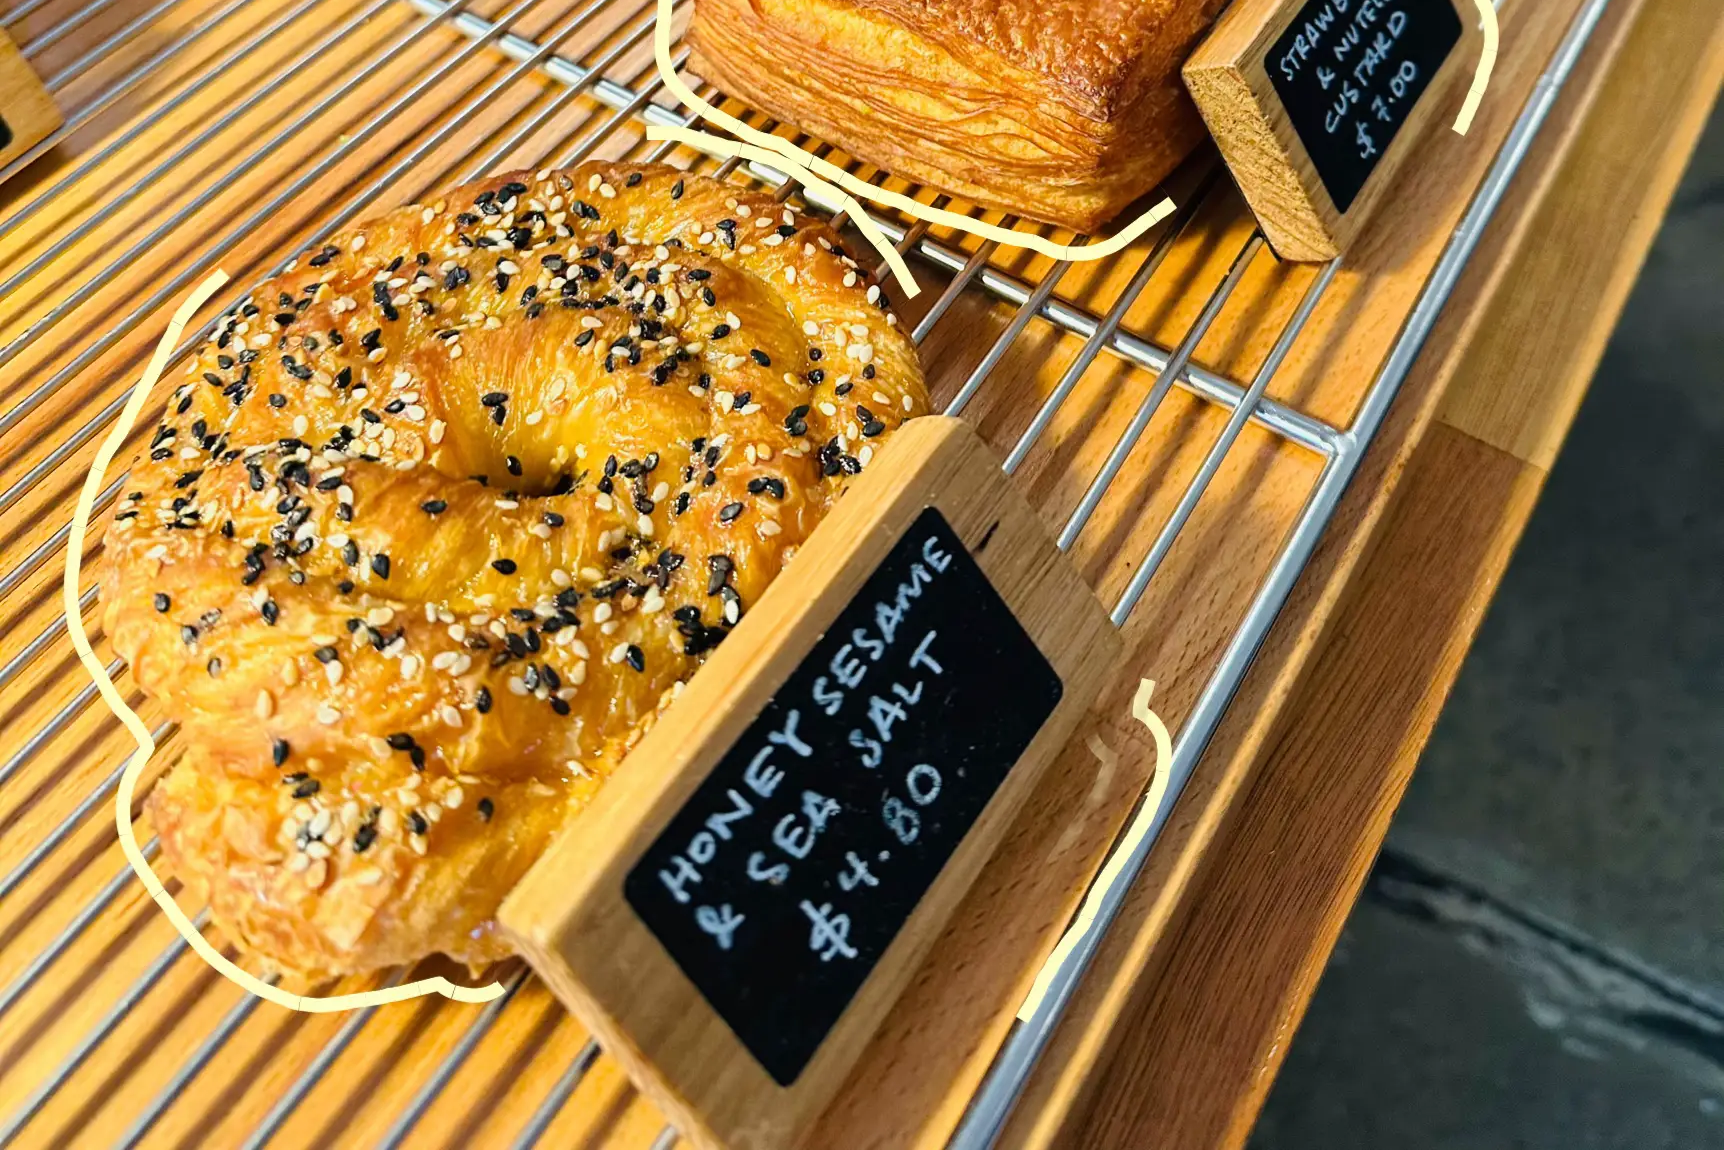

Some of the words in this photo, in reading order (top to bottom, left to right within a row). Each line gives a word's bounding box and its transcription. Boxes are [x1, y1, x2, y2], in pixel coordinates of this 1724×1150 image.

[1315, 65, 1337, 91] &
[1324, 10, 1407, 134] CUSTARD
[658, 709, 813, 904] HONEY
[813, 535, 954, 717] SESAME
[695, 903, 746, 950] &
[747, 789, 841, 885] SEA
[849, 629, 945, 769] SALT
